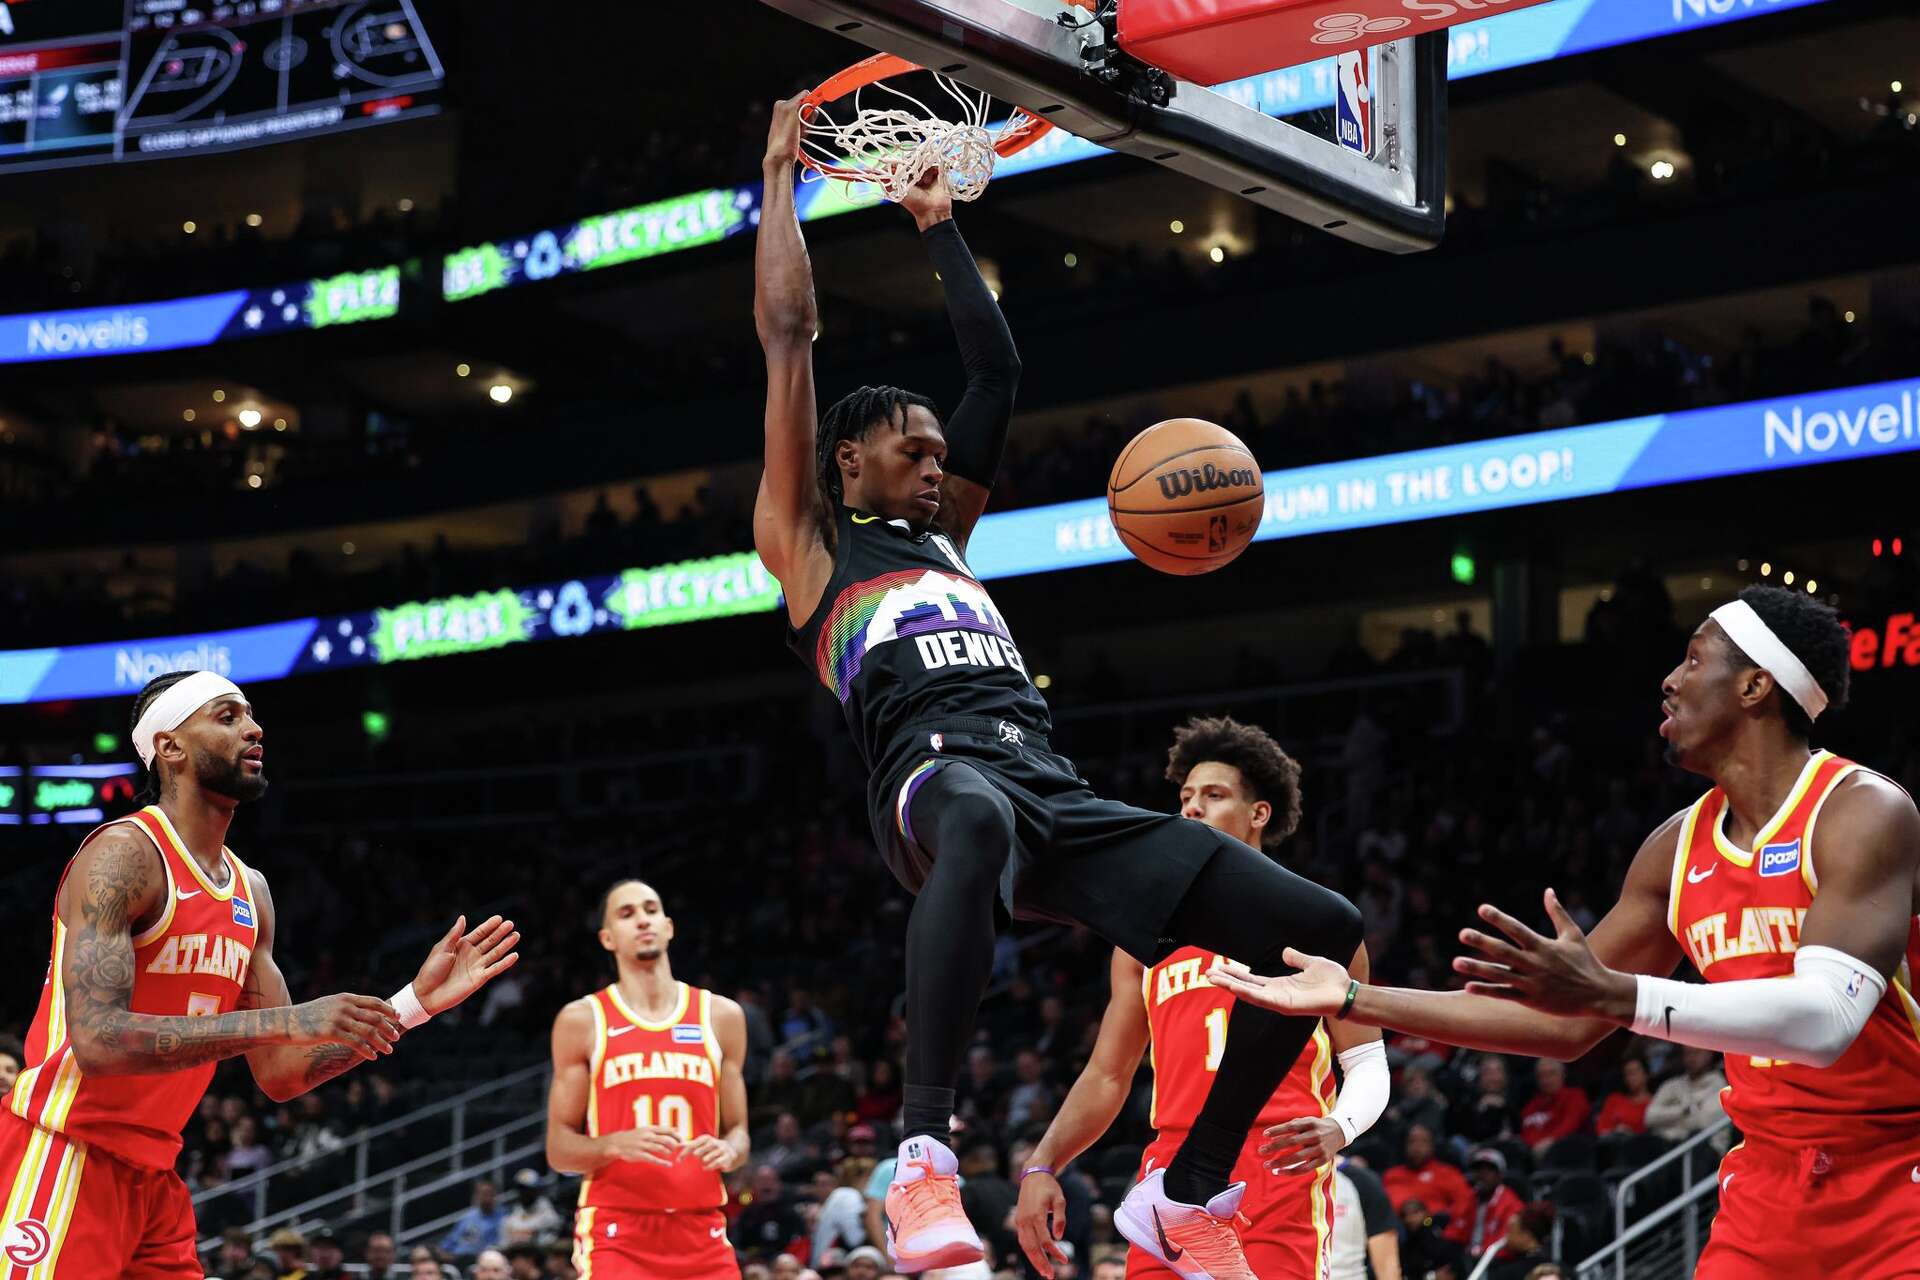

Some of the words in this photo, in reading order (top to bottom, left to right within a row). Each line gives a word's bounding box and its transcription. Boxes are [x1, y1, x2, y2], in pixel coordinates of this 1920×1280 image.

[1341, 118, 1358, 144] NBA
[575, 190, 724, 260] RECYCLE
[27, 311, 149, 354] Novelis
[1764, 387, 1920, 459] Novel
[1156, 463, 1256, 500] Wilson
[1337, 479, 1376, 513] IN
[1386, 465, 1452, 507] THE
[1463, 447, 1574, 495] LOOP!
[393, 602, 504, 652] PLEASE
[624, 560, 770, 618] RECYCLE
[146, 934, 252, 989] ATLANT
[1205, 1007, 1227, 1072] 1
[603, 1051, 714, 1089] ATLANTA
[632, 1094, 693, 1141] 10
